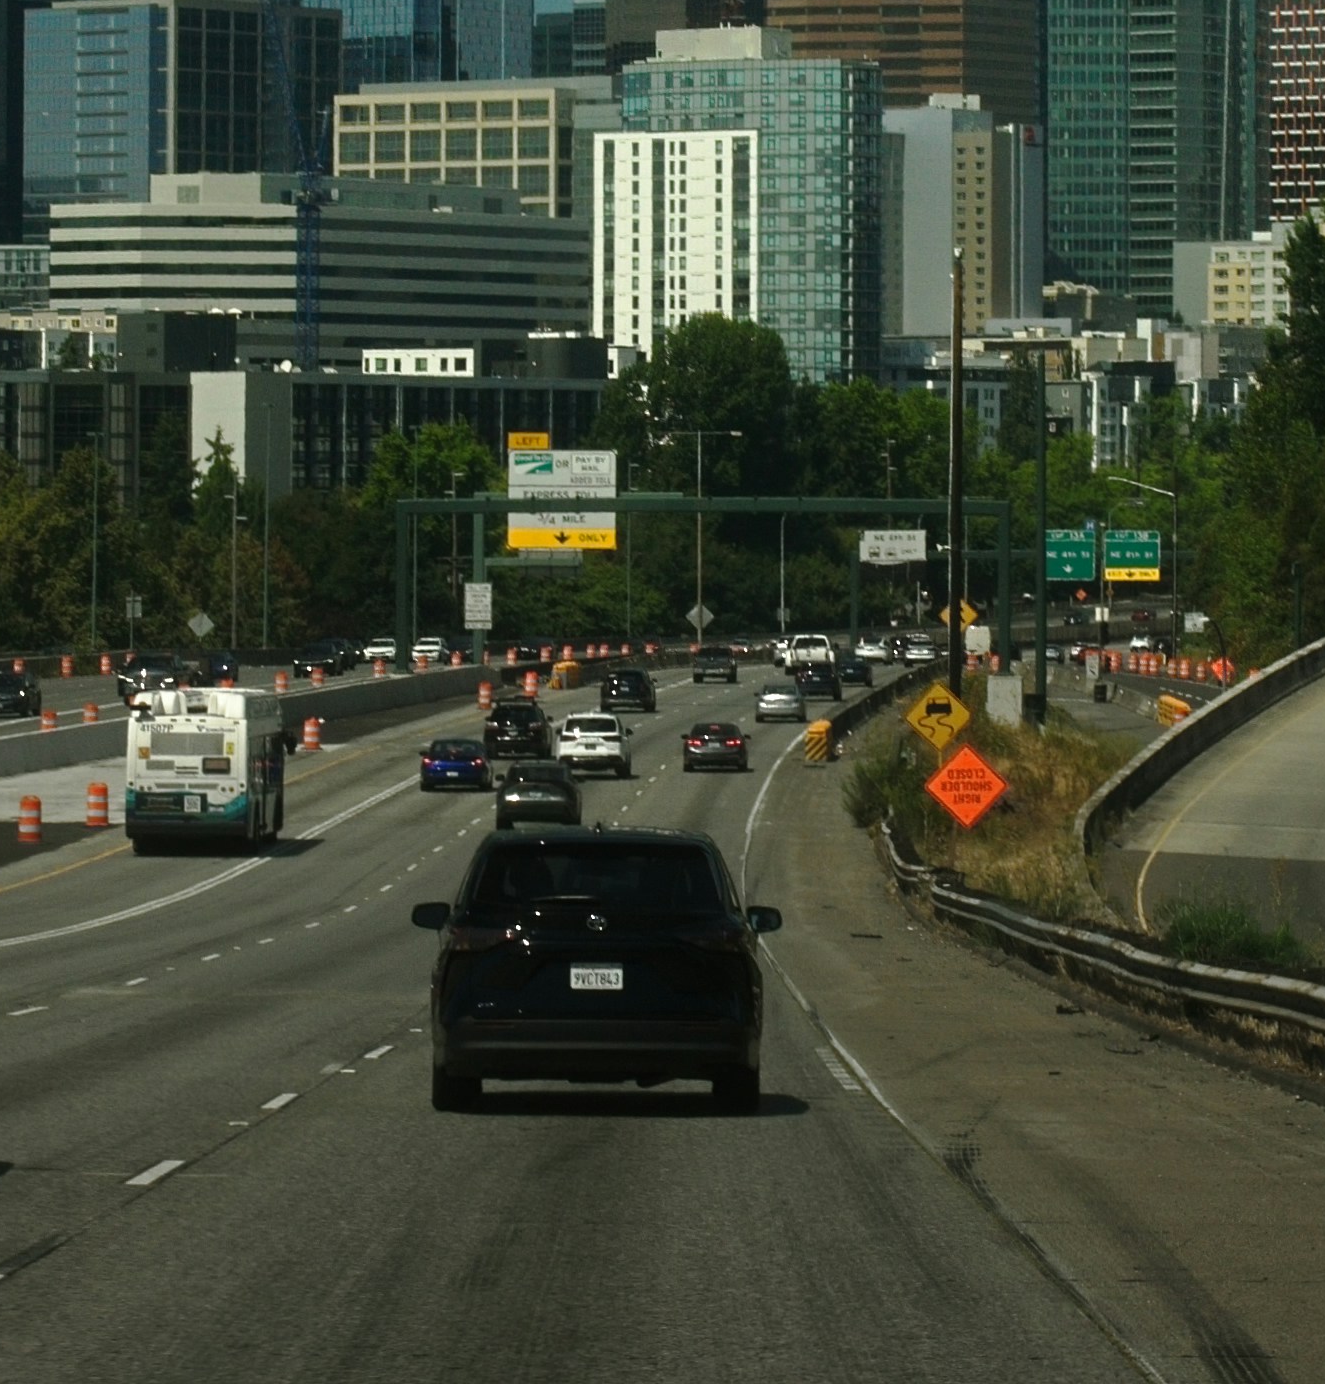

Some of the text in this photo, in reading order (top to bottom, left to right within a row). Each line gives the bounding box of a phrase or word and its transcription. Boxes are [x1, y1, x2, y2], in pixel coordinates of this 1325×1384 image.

[516, 437, 540, 446] LEFT
[555, 460, 569, 468] OR
[562, 515, 586, 523] MILE
[578, 534, 608, 542] ONLY
[947, 768, 986, 780] CLOSED
[940, 781, 993, 792] SHOULDER
[953, 794, 981, 804] RIGHT
[573, 971, 620, 986] 9VCT843
